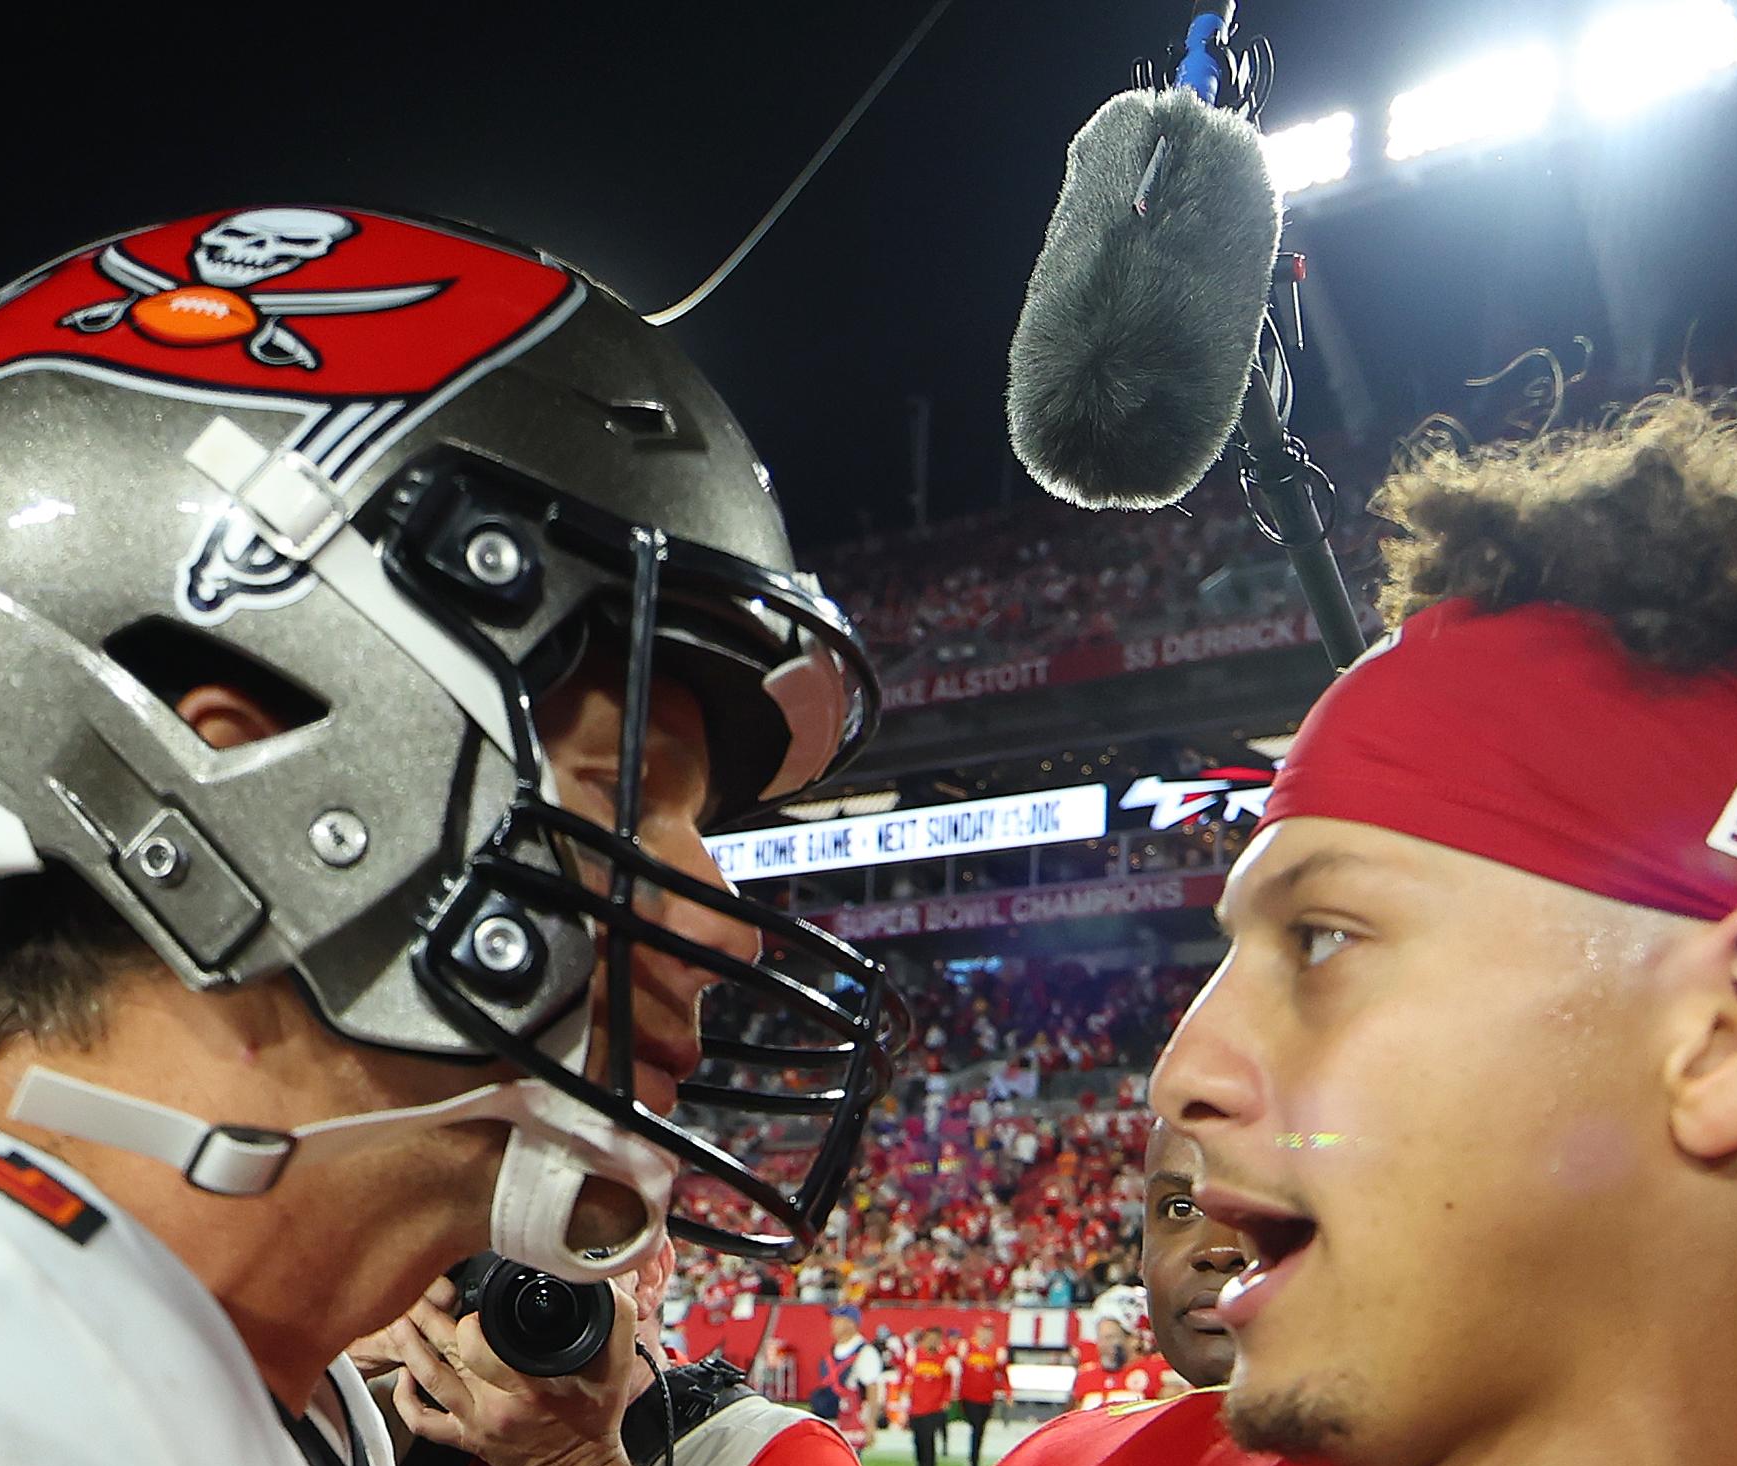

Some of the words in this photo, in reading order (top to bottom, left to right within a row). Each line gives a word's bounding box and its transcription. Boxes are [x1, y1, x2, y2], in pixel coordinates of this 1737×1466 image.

[1162, 616, 1296, 664] DERRICK
[930, 656, 1050, 699] ALSTOTT
[755, 834, 797, 867] HOME
[877, 819, 918, 853] NEXT
[927, 808, 996, 847] SUNDAY
[832, 902, 920, 940] SUPER
[926, 895, 1009, 932] BOWL
[1010, 878, 1184, 926] CHAMPIONS
